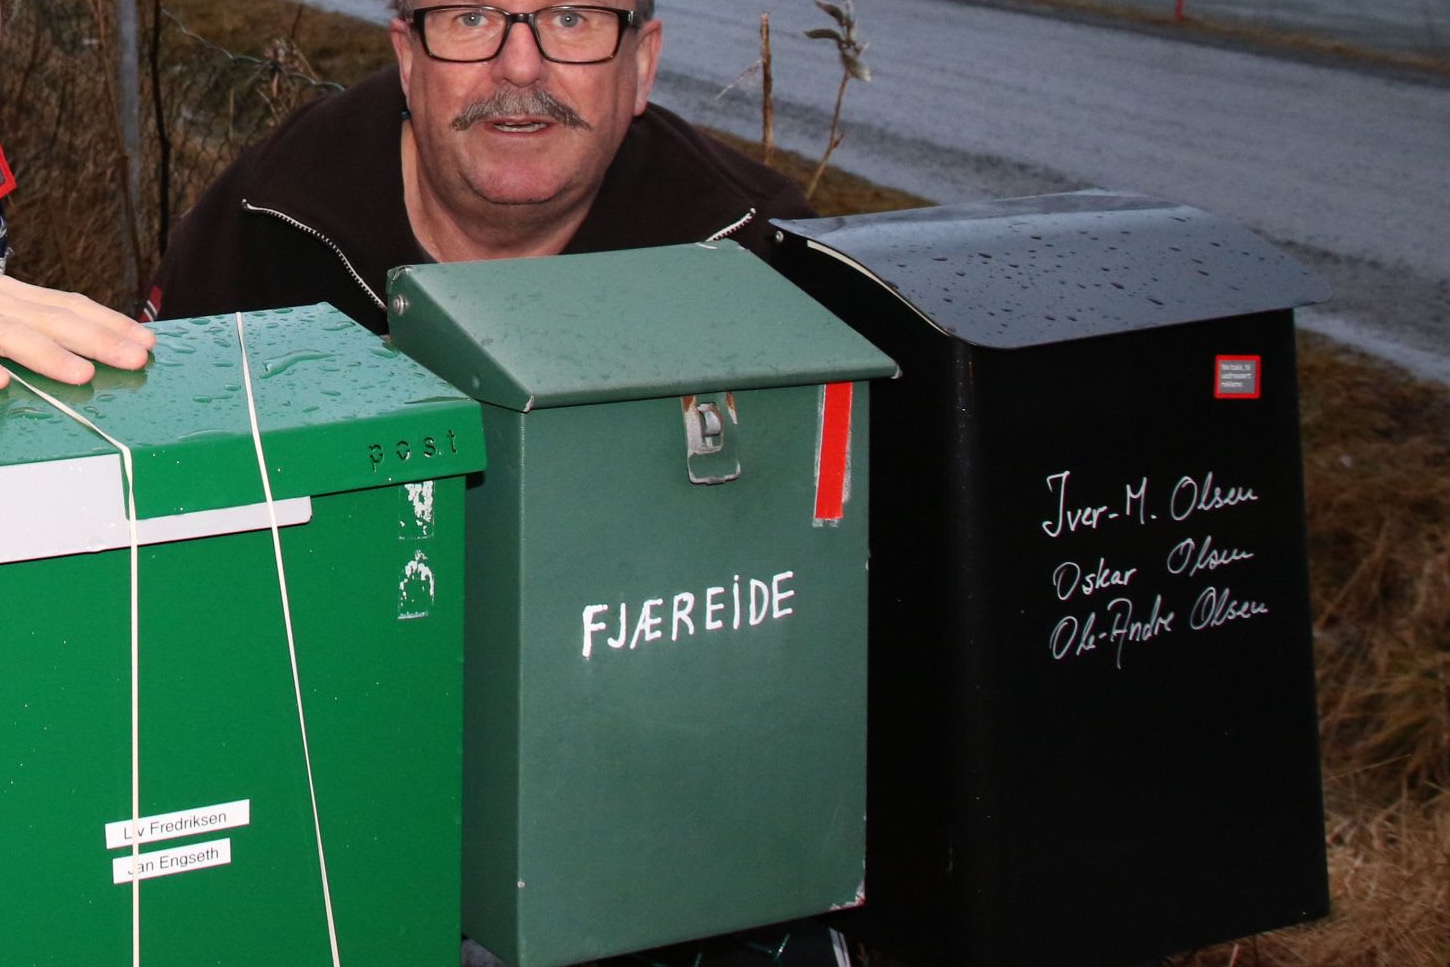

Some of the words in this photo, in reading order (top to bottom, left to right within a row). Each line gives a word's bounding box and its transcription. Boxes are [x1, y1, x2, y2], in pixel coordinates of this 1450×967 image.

[368, 429, 457, 473] post
[1170, 470, 1259, 522] Olsen
[1052, 557, 1138, 601] Oskar
[1166, 535, 1255, 578] Olsen
[1189, 586, 1269, 631] Olsen
[123, 826, 146, 840] Lv
[149, 812, 228, 835] Fredriksen
[159, 847, 220, 870] Engseth
